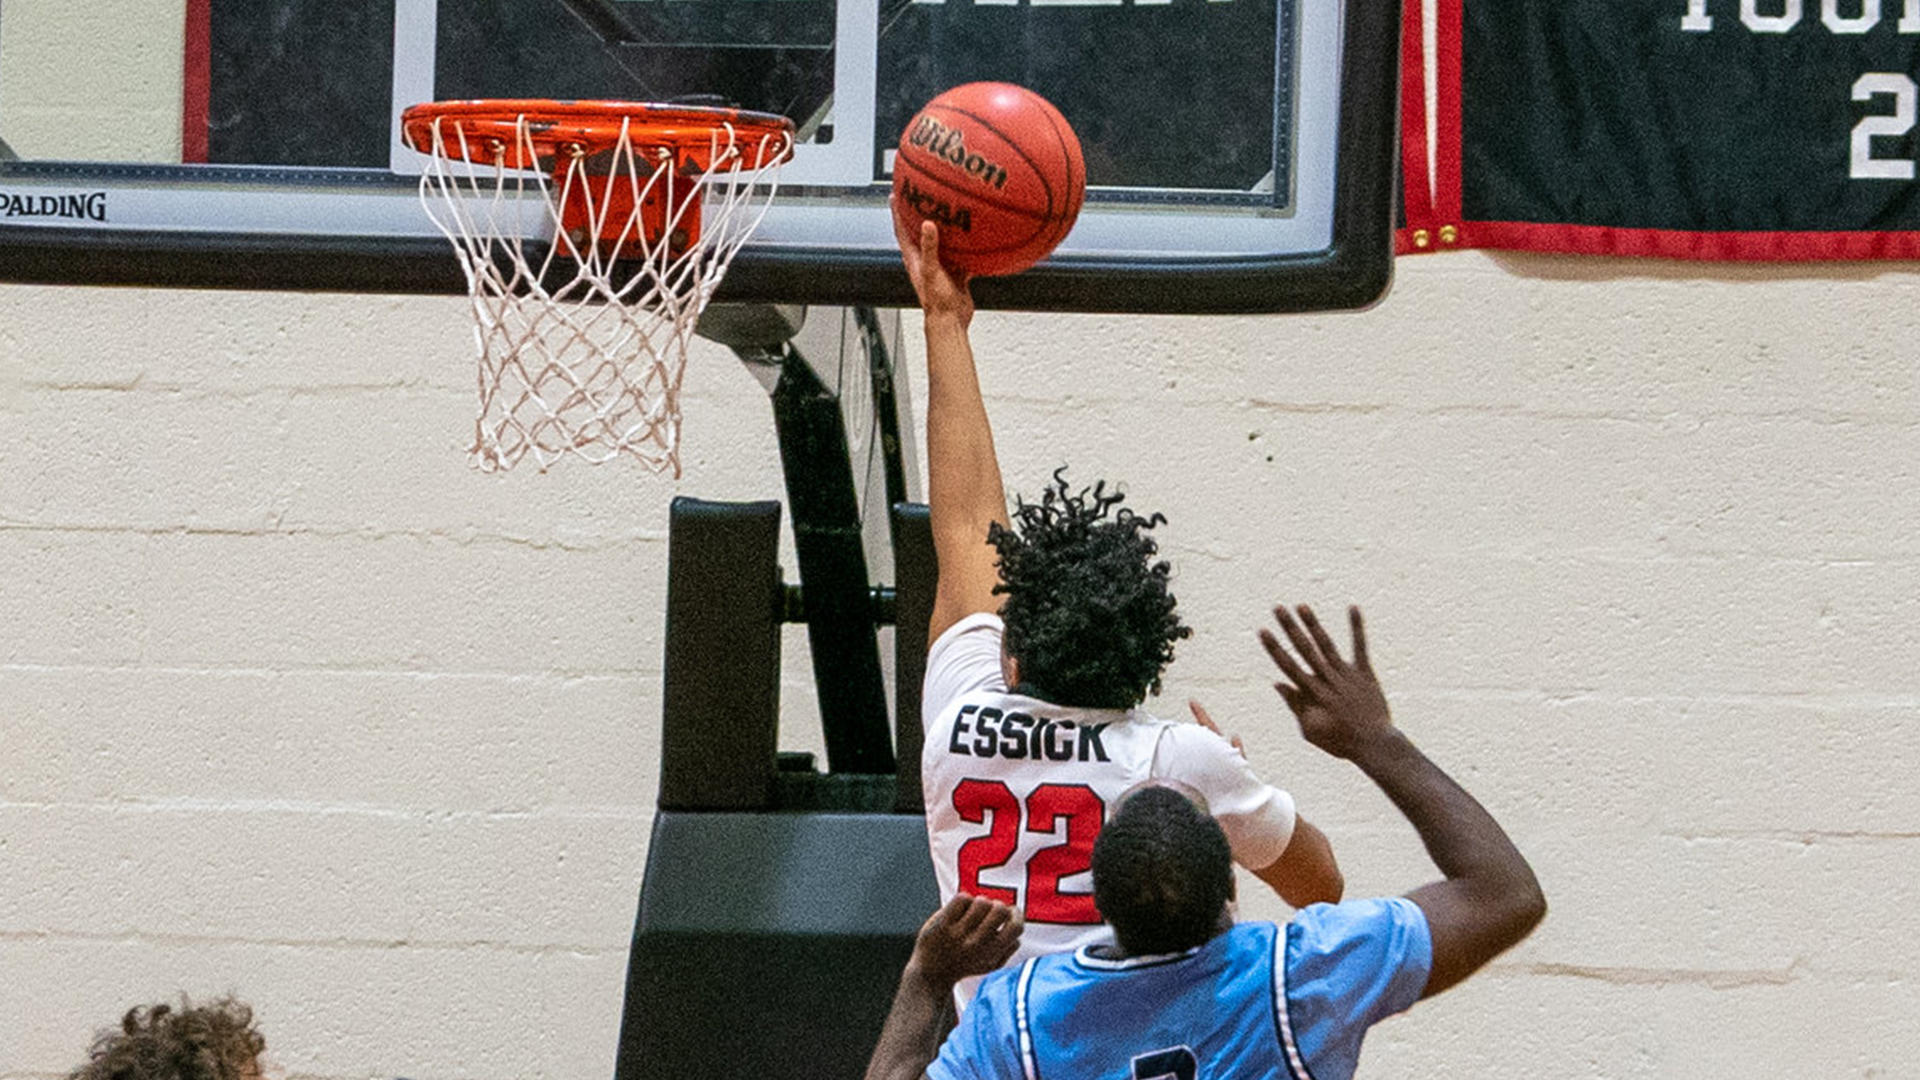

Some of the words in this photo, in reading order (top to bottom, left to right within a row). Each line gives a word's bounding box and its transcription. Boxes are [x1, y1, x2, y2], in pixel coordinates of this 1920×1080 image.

[908, 113, 1008, 191] Wilson
[900, 177, 972, 232] NCAA
[948, 704, 1112, 763] ESSICK
[951, 777, 1106, 925] 22
